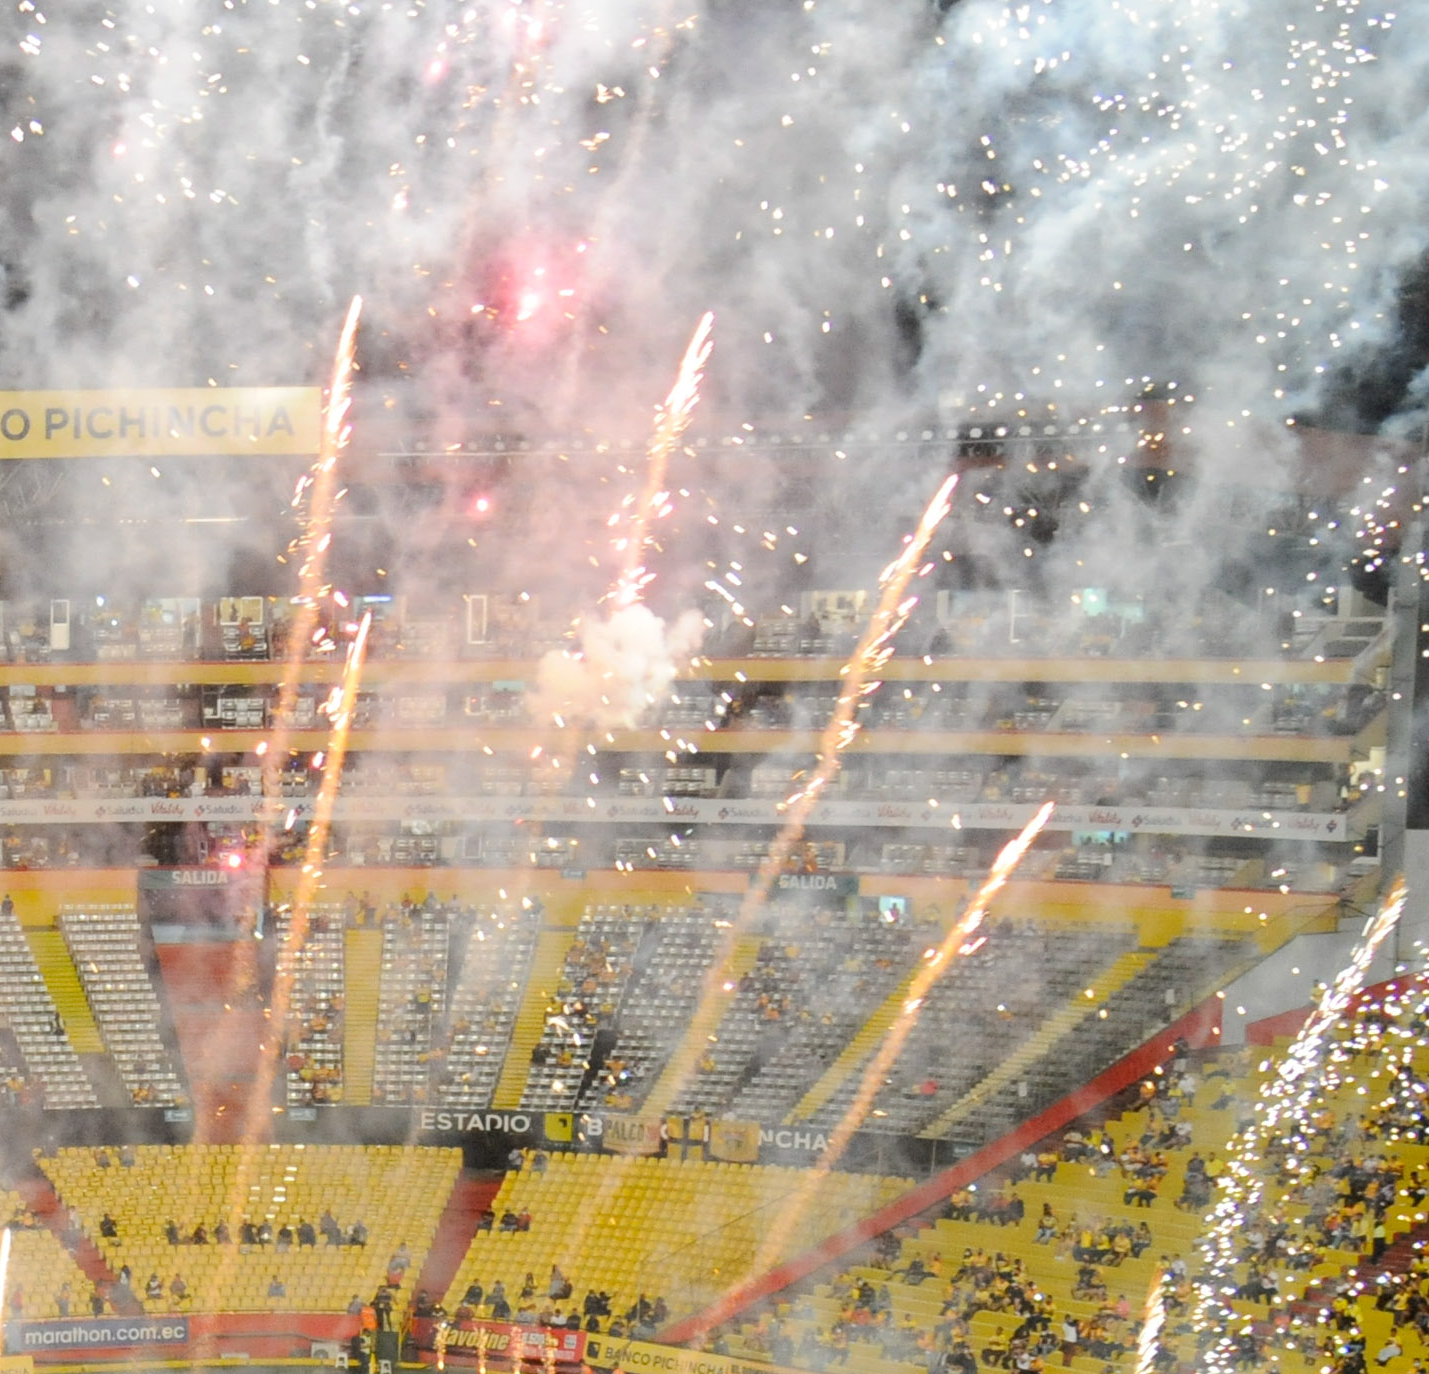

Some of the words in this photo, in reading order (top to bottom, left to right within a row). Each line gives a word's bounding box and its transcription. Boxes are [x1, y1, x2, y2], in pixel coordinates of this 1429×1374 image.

[44, 404, 296, 441] PICHINCHA
[172, 871, 227, 885] SALIDA
[779, 875, 837, 889] SALIDA
[421, 1112, 530, 1133] ESTADIO
[25, 1326, 184, 1345] marathon.com.ec
[605, 1347, 650, 1366] BANCO
